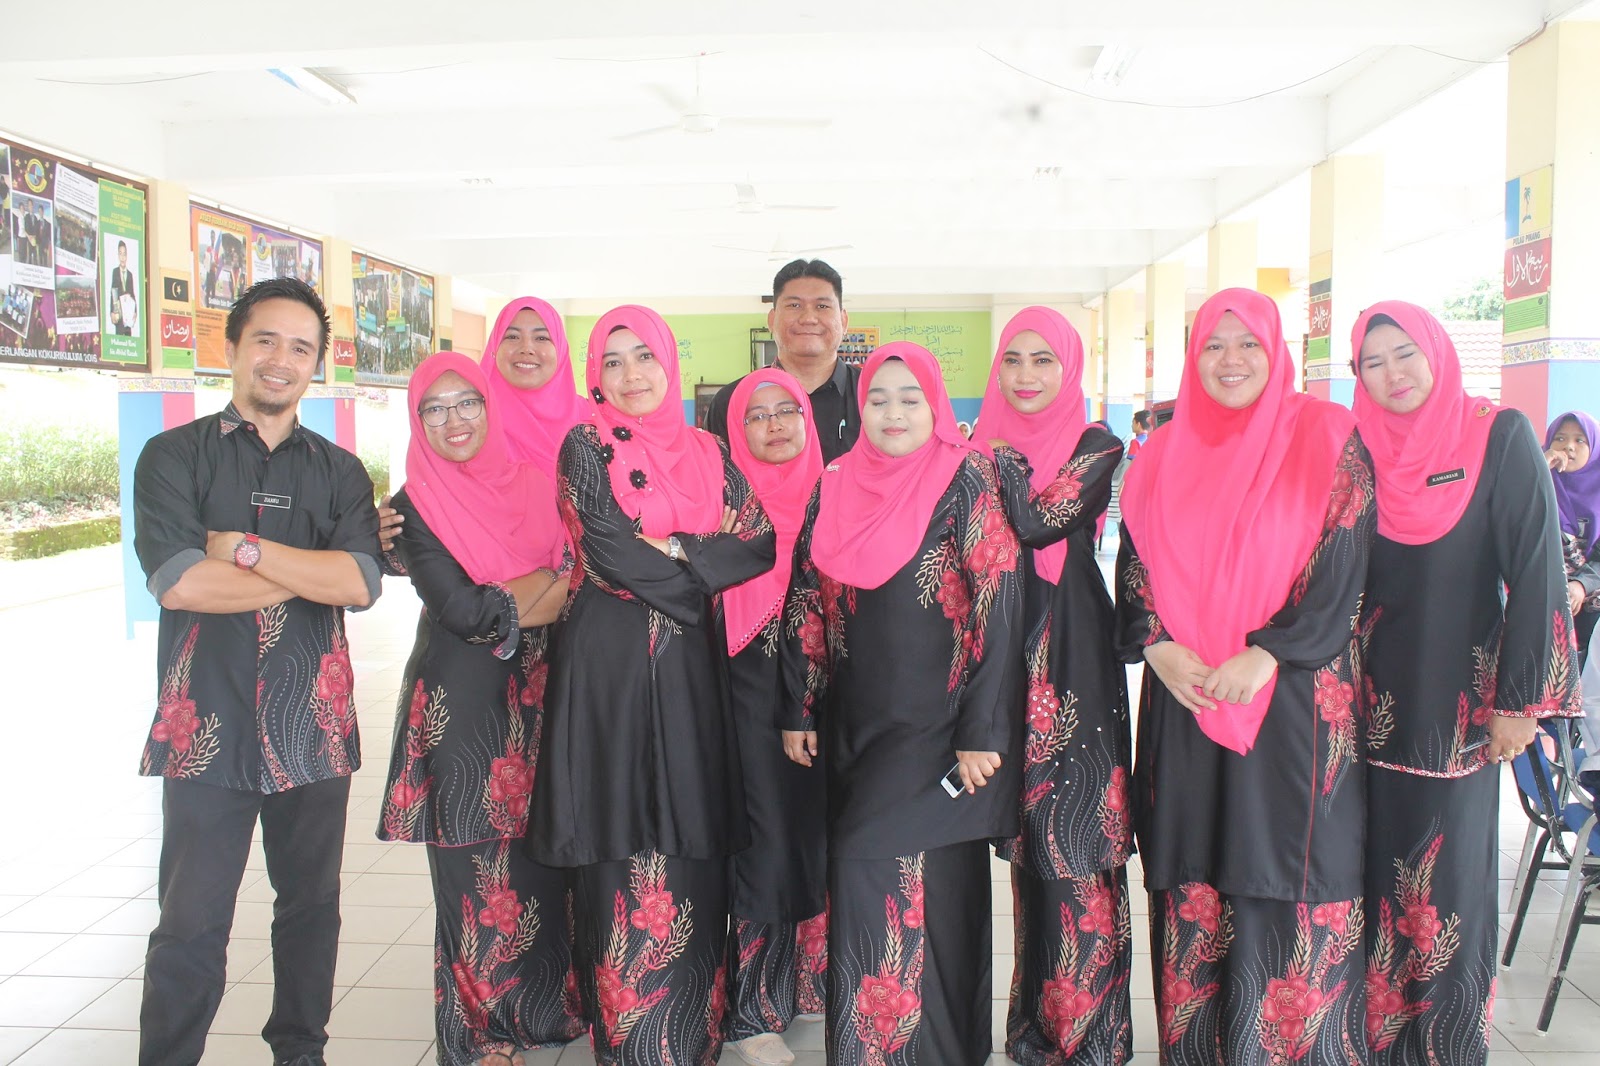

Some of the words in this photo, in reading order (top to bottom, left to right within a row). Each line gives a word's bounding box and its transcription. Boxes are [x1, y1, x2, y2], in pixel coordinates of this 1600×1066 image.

[1512, 235, 1525, 246] PULAU
[1525, 231, 1541, 242] PINANG
[163, 319, 190, 343] رمضان
[0, 345, 37, 358] ERLANGAN
[38, 349, 83, 362] KOKURIKULUM
[83, 353, 98, 363] 2016
[1432, 472, 1459, 482] KAMARIAH
